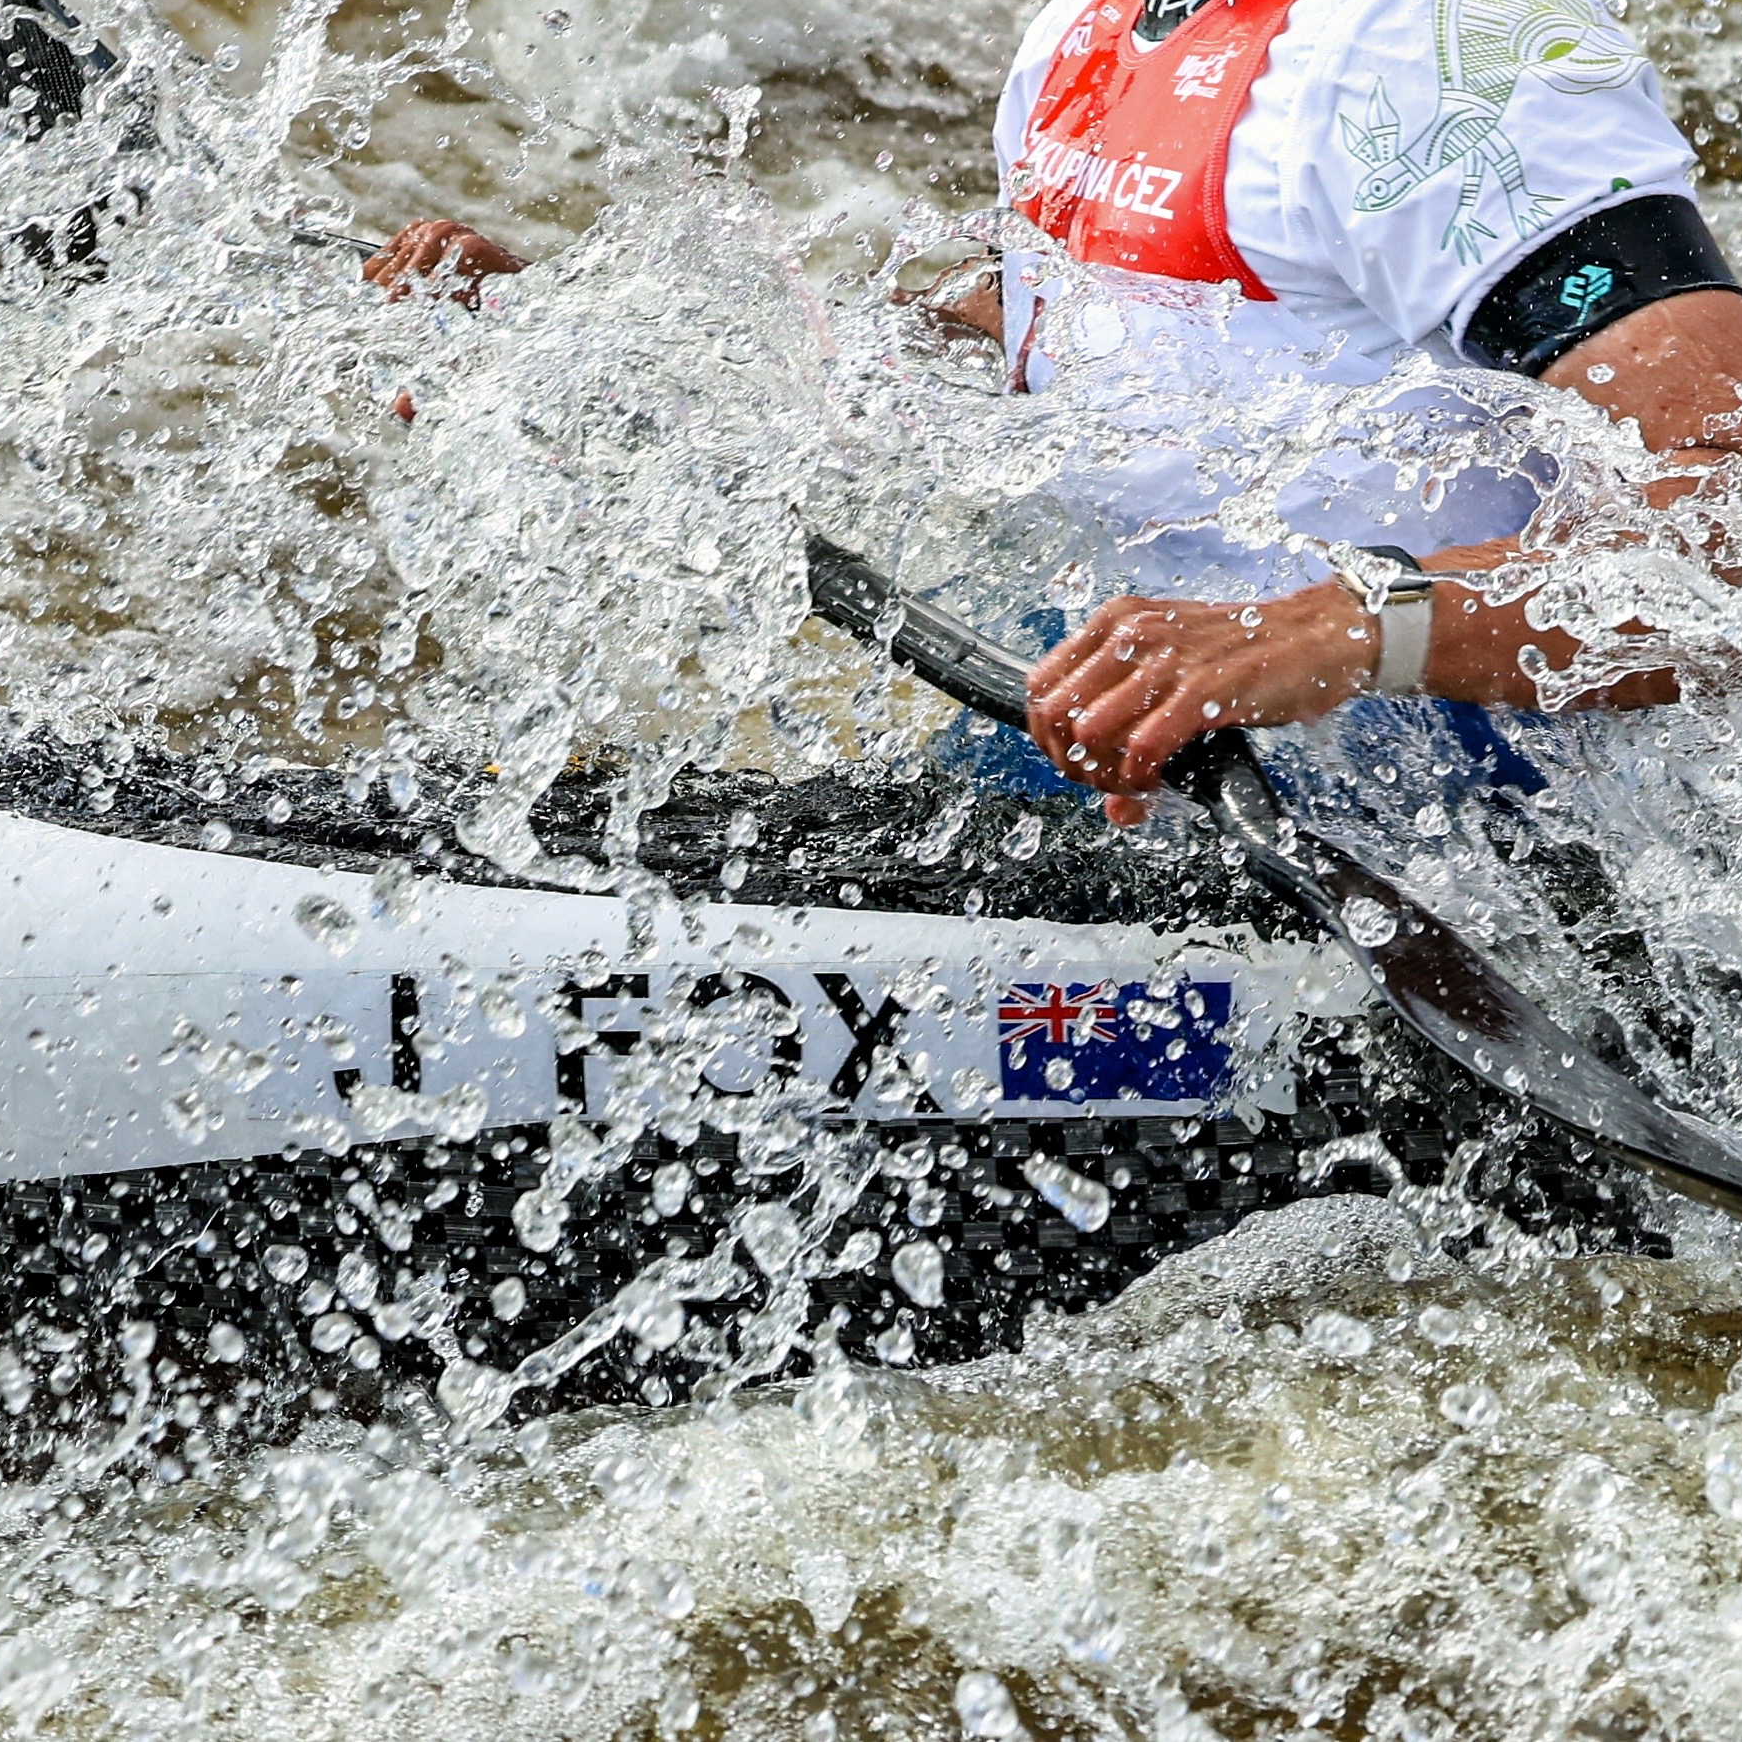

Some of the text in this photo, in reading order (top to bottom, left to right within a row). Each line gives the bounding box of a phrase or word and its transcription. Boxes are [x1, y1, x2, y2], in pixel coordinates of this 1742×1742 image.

[1112, 151, 1183, 220] ČEZ
[333, 970, 944, 1114] J FOX
